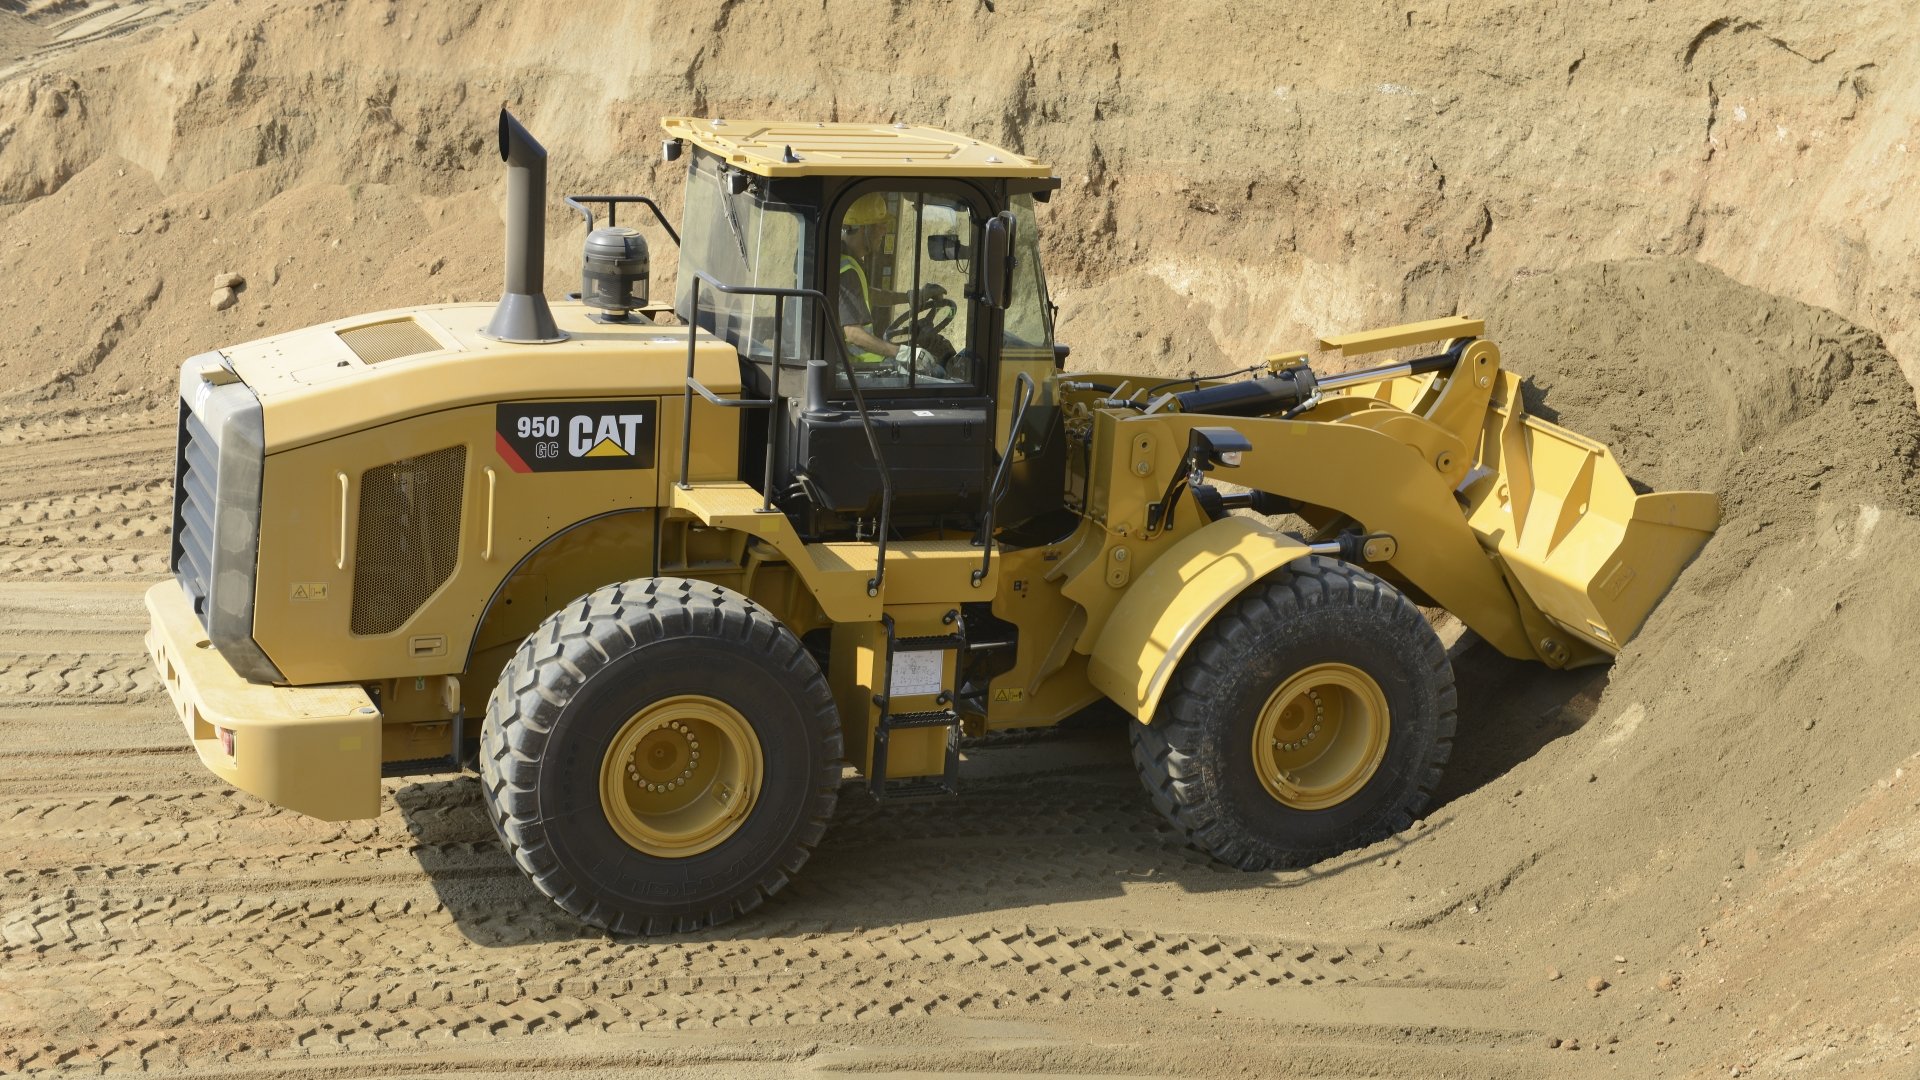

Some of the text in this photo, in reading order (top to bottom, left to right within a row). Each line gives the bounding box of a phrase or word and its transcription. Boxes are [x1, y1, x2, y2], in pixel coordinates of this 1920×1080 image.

[517, 416, 560, 438] 950
[568, 414, 643, 458] CAT
[535, 441, 559, 459] GC
